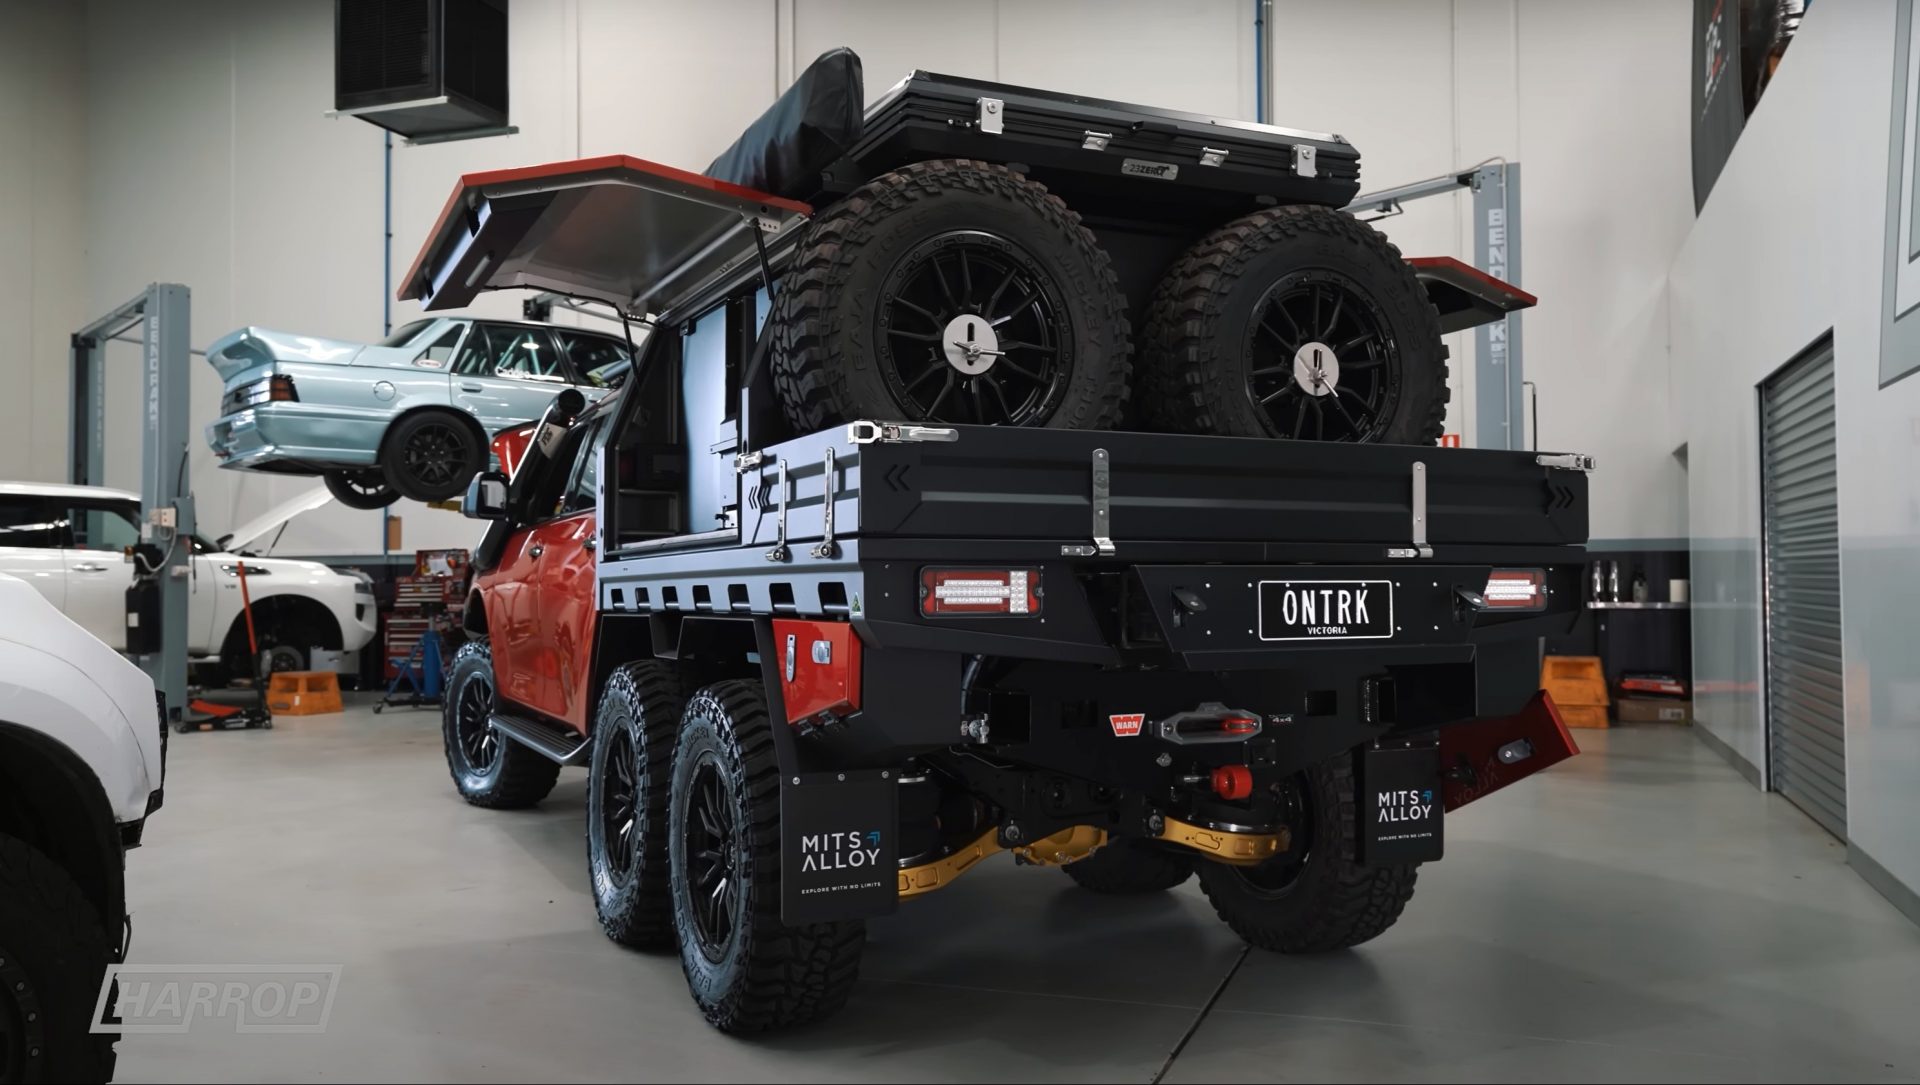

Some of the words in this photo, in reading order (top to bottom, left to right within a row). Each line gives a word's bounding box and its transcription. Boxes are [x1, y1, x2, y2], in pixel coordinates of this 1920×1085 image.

[1488, 209, 1505, 341] BENDK
[1282, 589, 1370, 625] ONTRK
[1307, 626, 1348, 635] VICTORIA
[1115, 720, 1138, 730] WARN
[1378, 790, 1419, 807] MITS
[1378, 805, 1432, 822] ALLOY
[802, 831, 861, 853] MITS
[801, 848, 880, 872] ALLOY
[801, 887, 829, 895] EXPLORE
[831, 884, 848, 892] WITH
